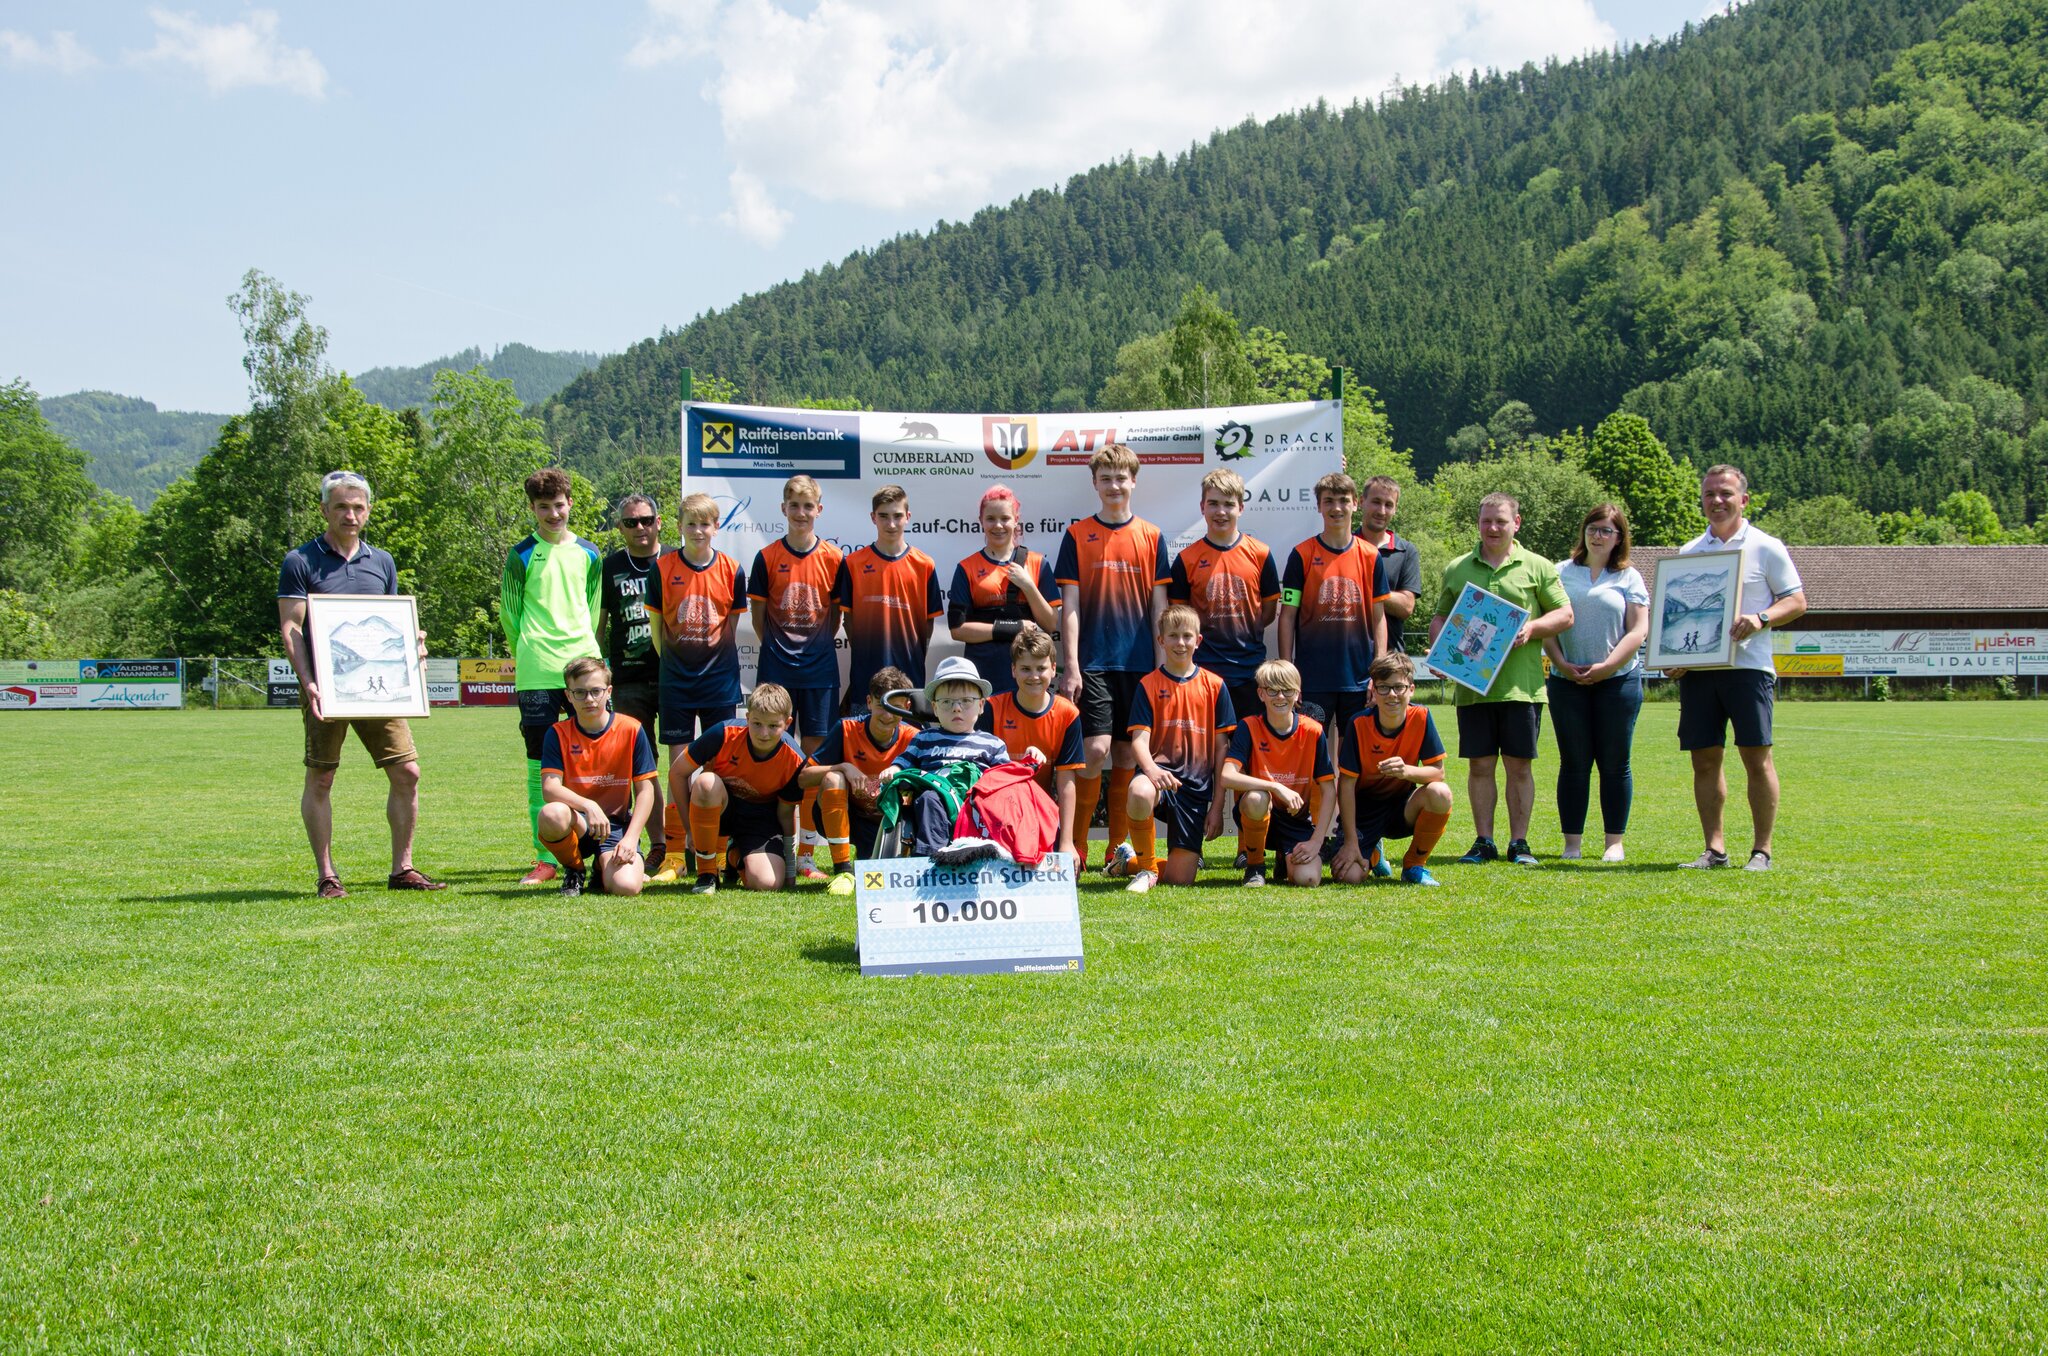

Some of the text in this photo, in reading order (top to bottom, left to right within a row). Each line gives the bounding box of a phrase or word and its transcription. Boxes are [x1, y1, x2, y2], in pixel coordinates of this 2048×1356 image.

[738, 427, 844, 442] Raiffeisenbank
[1127, 424, 1201, 434] Anlagentechnik
[1126, 433, 1202, 442] Lachmair GmbH
[1264, 432, 1334, 445] DRACK
[739, 442, 779, 455] Almtal
[873, 452, 974, 464] CUMBERLAND
[1171, 455, 1201, 463] Technology
[874, 465, 975, 476] WILDPARK GRÜNAU
[1243, 488, 1311, 502] DAUE
[1040, 518, 1065, 533] für
[1284, 590, 1293, 602] C
[1974, 636, 2036, 651] HUEMER
[1862, 655, 1888, 664] Recht
[1927, 656, 2015, 667] LIDAUER
[427, 684, 455, 693] hober
[467, 682, 517, 694] wüstenr
[889, 867, 1069, 889] Raiffeisen Scheck
[868, 899, 1018, 924] € 10.000
[1014, 963, 1069, 972] Raiffeisenbank
